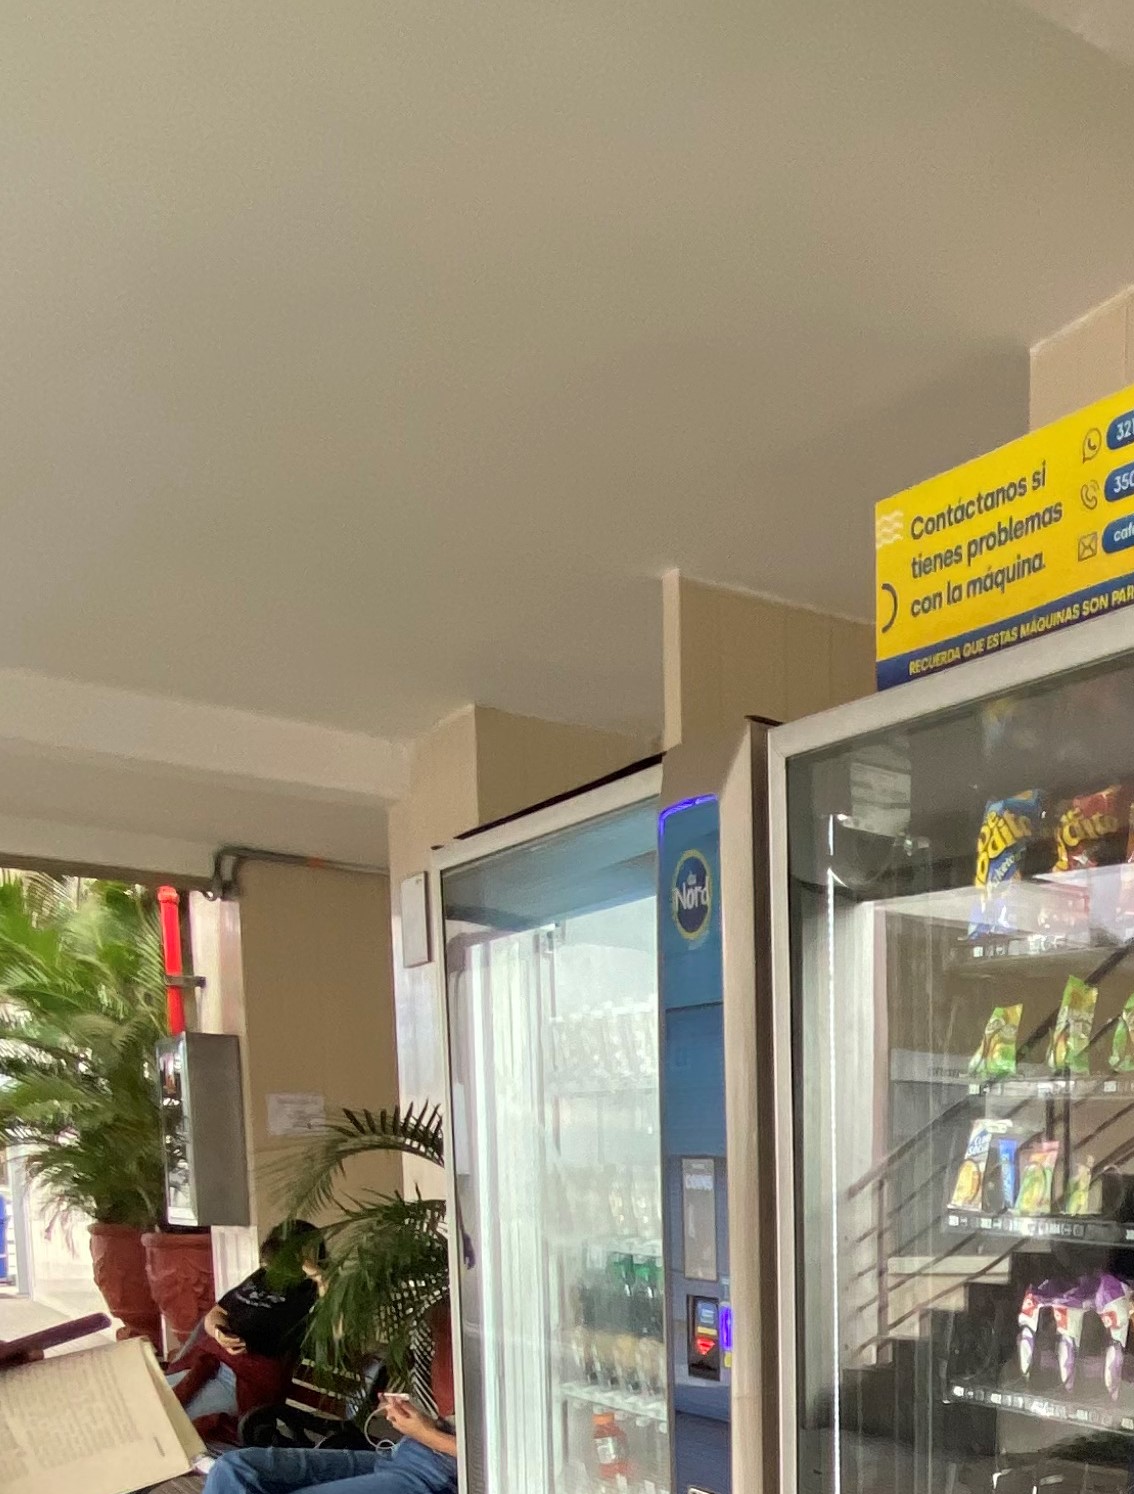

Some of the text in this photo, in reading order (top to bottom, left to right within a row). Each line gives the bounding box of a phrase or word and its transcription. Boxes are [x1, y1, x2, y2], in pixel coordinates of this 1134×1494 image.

[911, 459, 1047, 540] Contáctanos si
[911, 501, 1063, 579] tienes problemas
[911, 551, 1047, 618] con la máquina.
[908, 646, 962, 676] RECUERDA
[962, 638, 985, 657] QUE
[986, 626, 1018, 648] ESTAS
[1019, 604, 1080, 638] MÁQUINAS
[1082, 594, 1109, 616] SON
[673, 876, 709, 911] Nord
